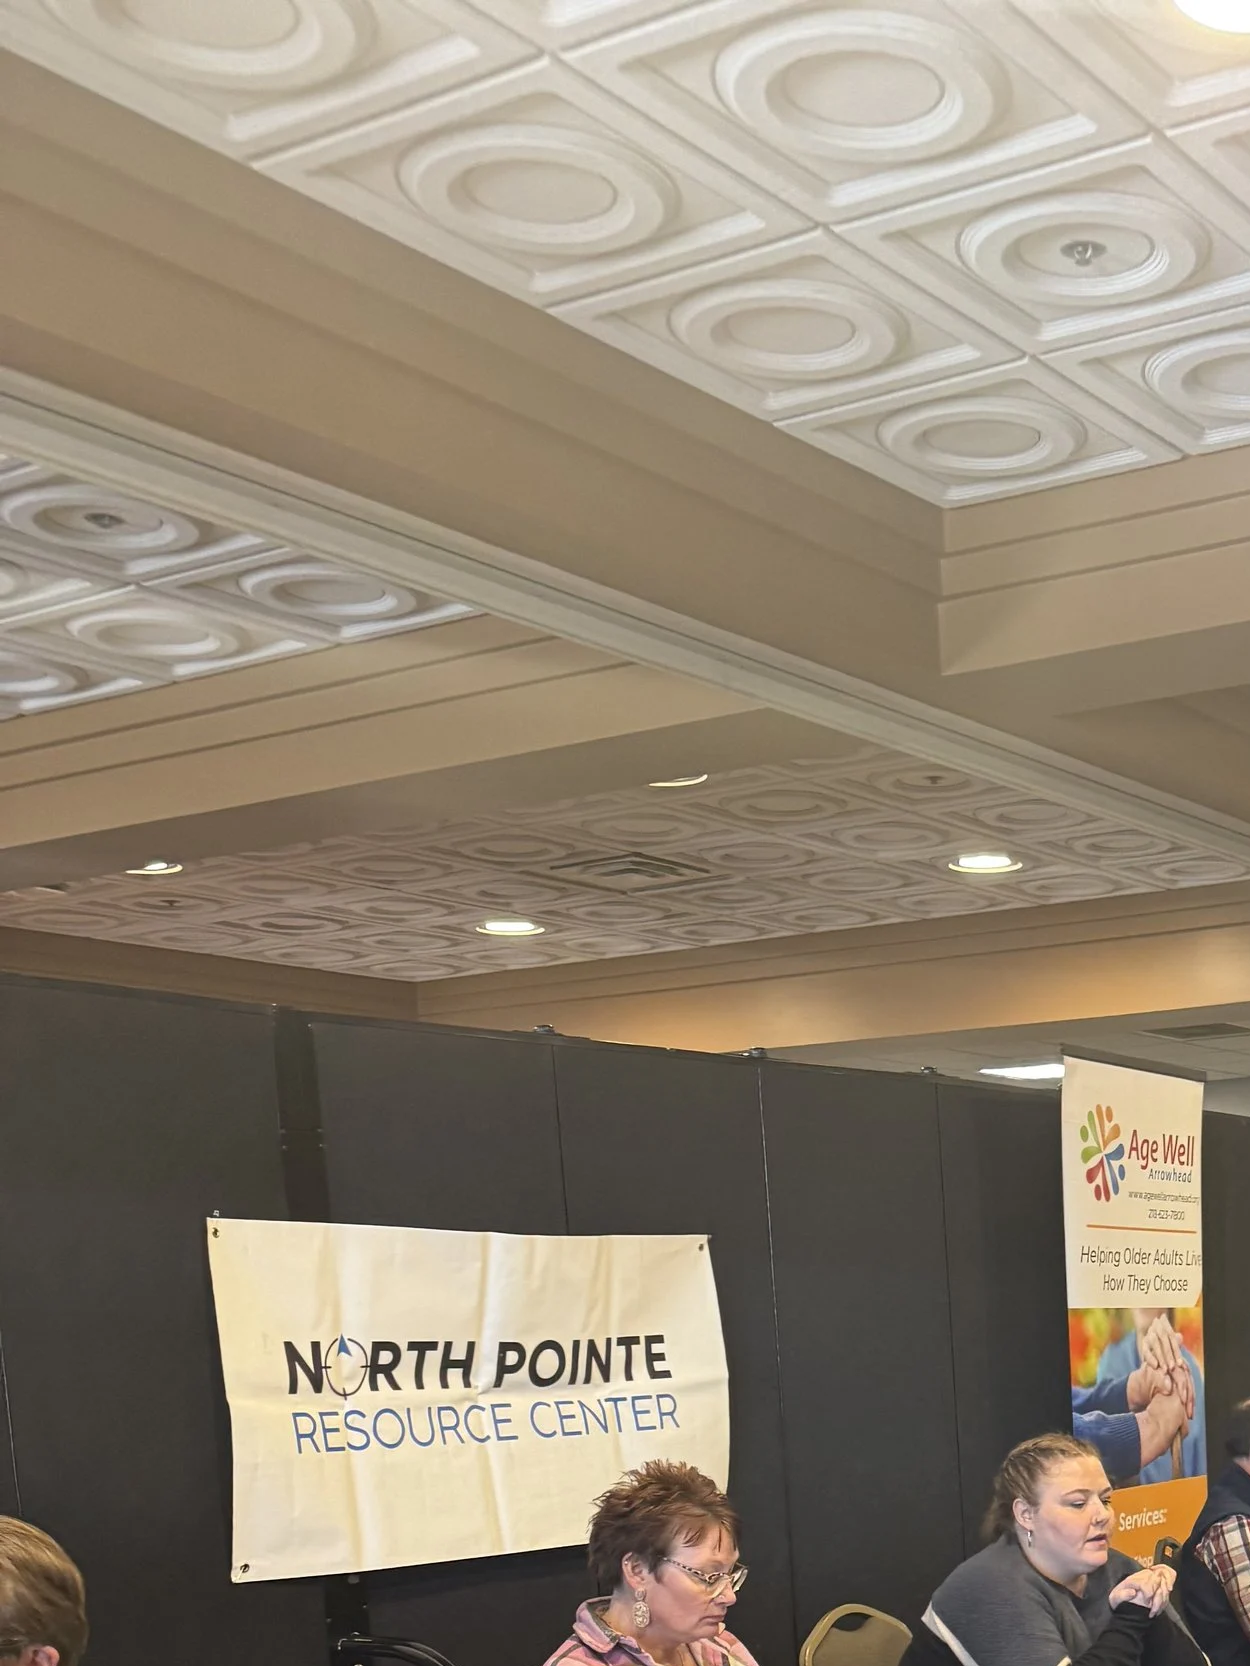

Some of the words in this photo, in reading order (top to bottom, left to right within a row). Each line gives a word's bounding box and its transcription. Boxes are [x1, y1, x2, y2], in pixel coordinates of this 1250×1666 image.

[1128, 1129, 1158, 1170] Age
[1163, 1133, 1195, 1167] Well
[1148, 1168, 1192, 1183] Arrowhead
[1080, 1246, 1121, 1267] Helping
[1124, 1248, 1151, 1265] Older
[1153, 1249, 1183, 1266] Adults
[1103, 1274, 1125, 1291] How
[1127, 1275, 1151, 1294] They
[1153, 1275, 1188, 1291] Choose
[283, 1334, 476, 1398] NORTH
[498, 1334, 673, 1388] POINTE
[292, 1403, 518, 1454] RESOURCE
[529, 1393, 680, 1439] CENTER
